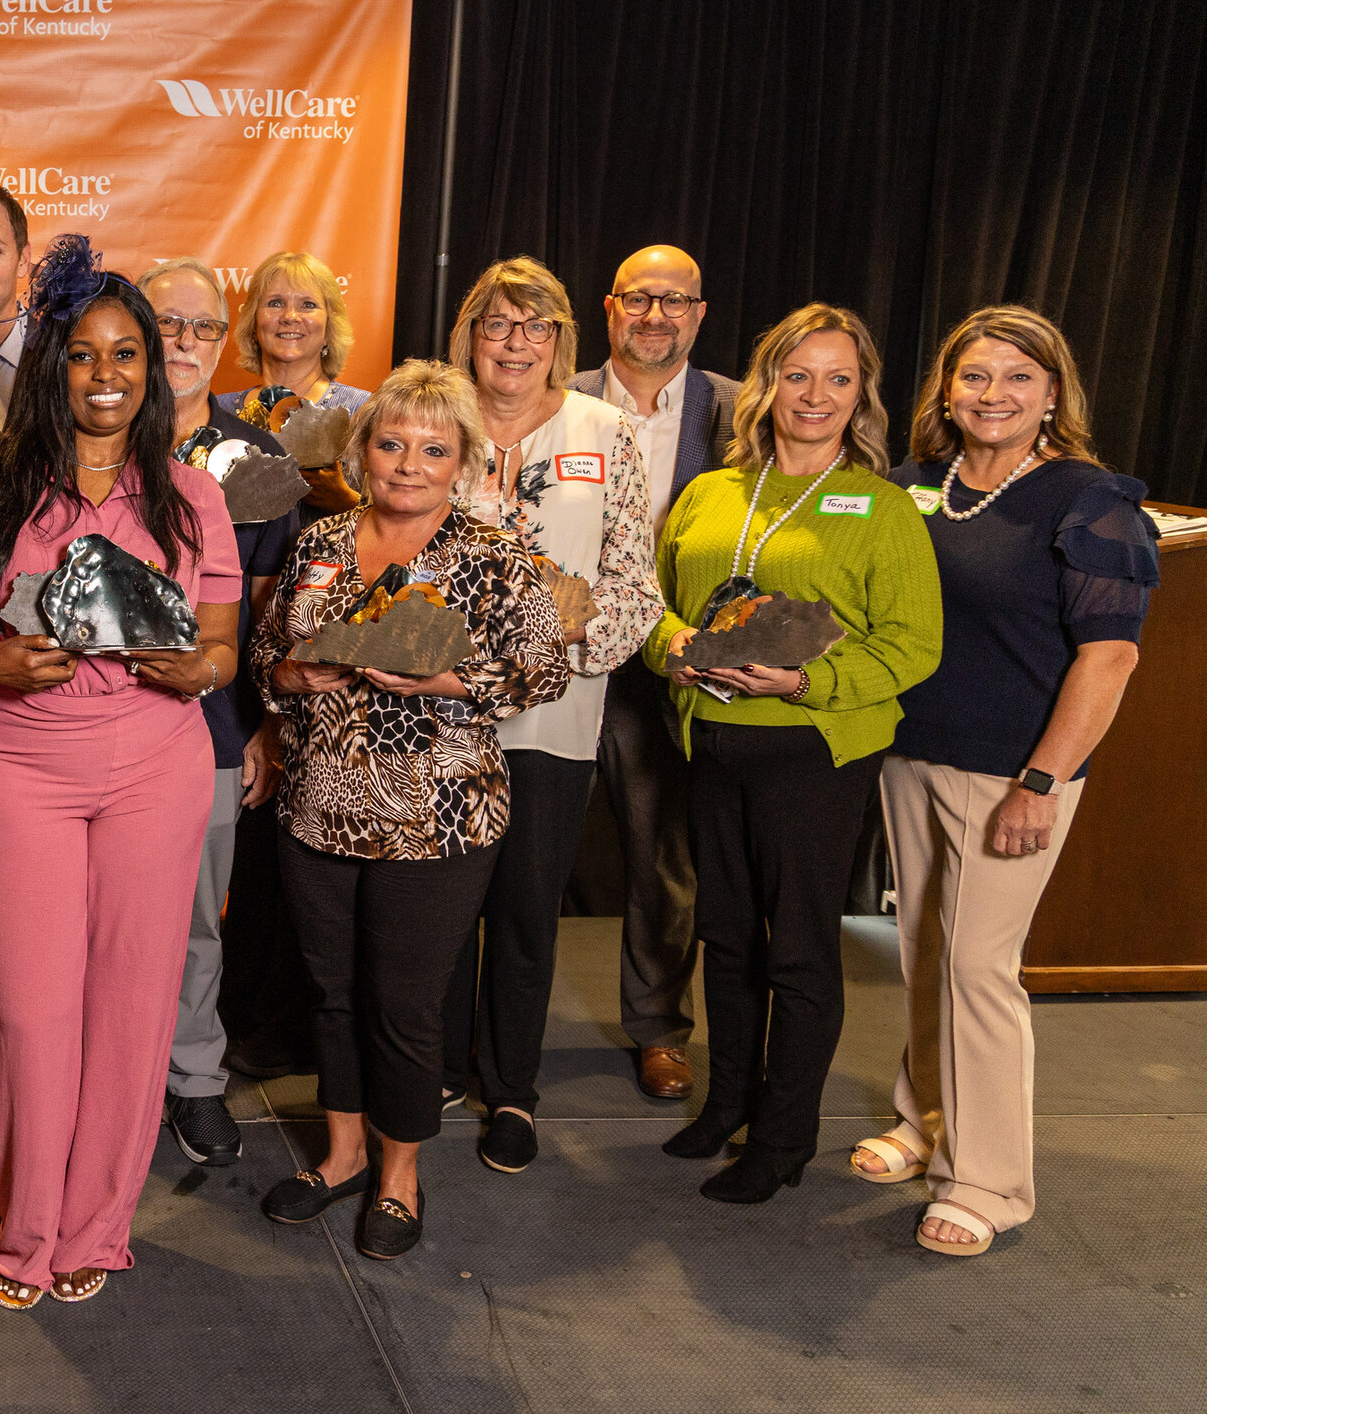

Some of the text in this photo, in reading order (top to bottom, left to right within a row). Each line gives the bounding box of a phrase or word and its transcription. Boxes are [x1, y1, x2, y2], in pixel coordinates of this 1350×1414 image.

[24, 16, 112, 41] Kentucky
[218, 88, 356, 118] WellCare
[243, 120, 355, 144] of Kentucky
[23, 198, 110, 221] Kentucky
[825, 498, 861, 511] Tonya
